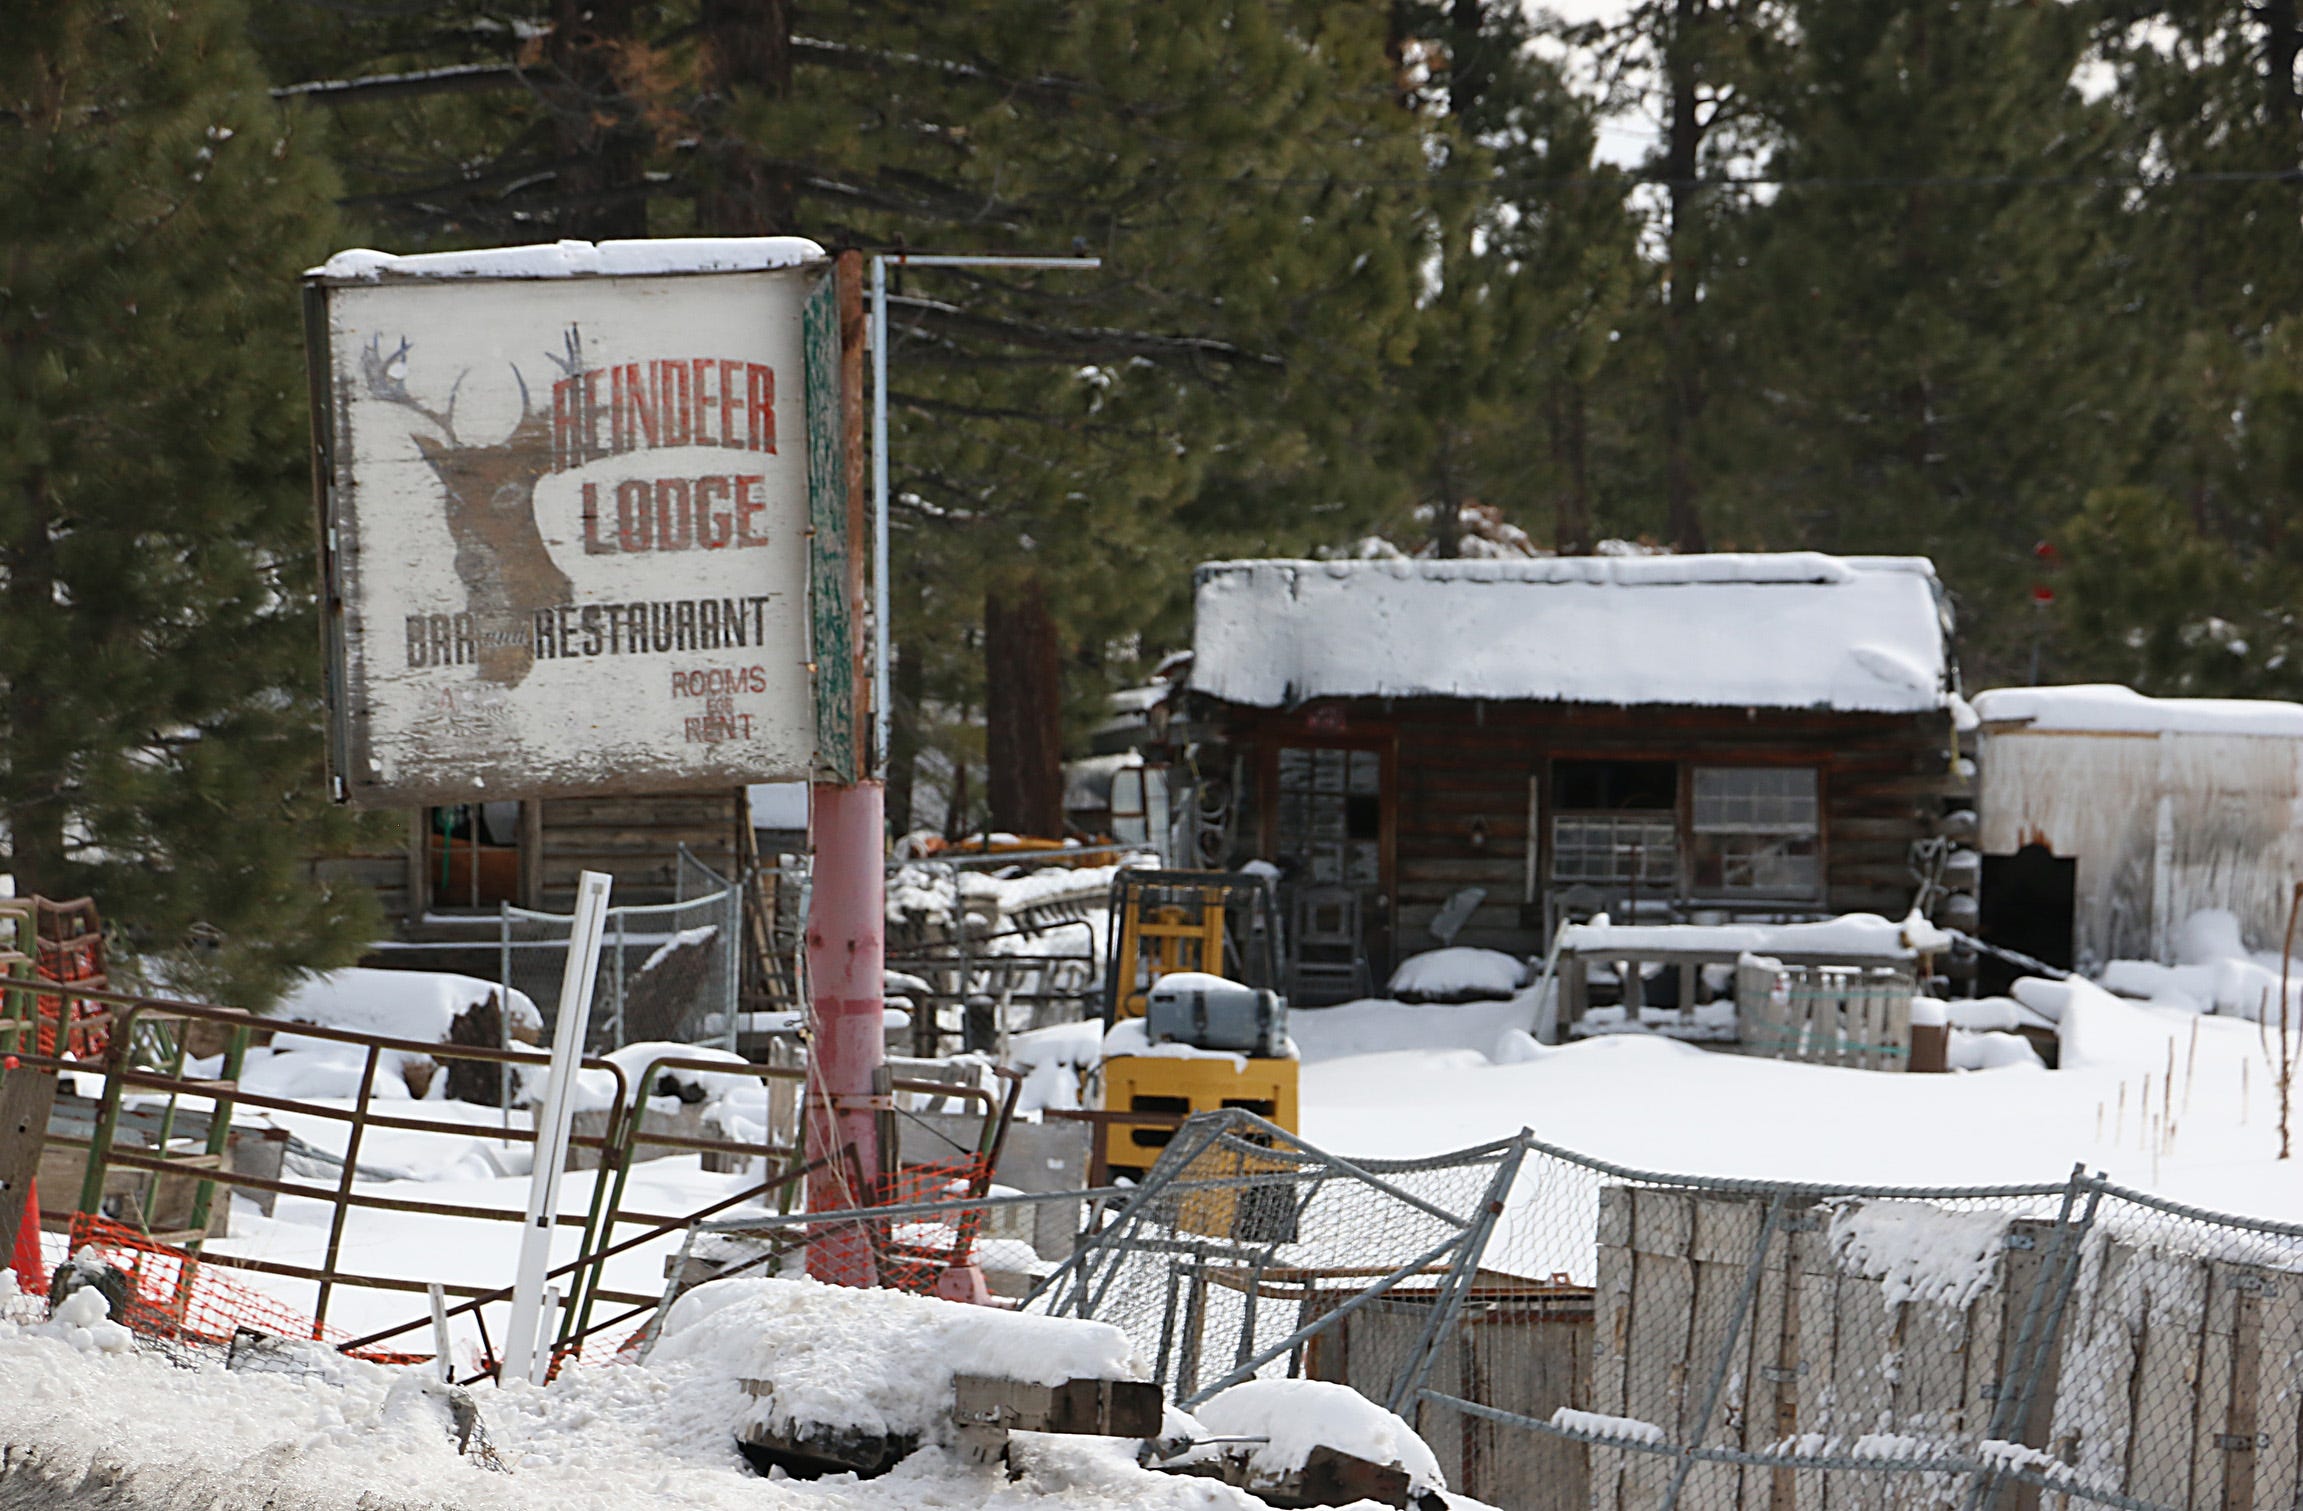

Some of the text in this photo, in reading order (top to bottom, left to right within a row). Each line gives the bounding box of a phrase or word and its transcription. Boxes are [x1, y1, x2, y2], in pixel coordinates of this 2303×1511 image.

[552, 358, 778, 475] REINDEER
[582, 474, 769, 555] LODGE
[405, 612, 476, 668] BAR
[534, 596, 769, 659] RESTAURANT
[671, 664, 767, 699] ROOMS
[684, 712, 755, 744] RENT
